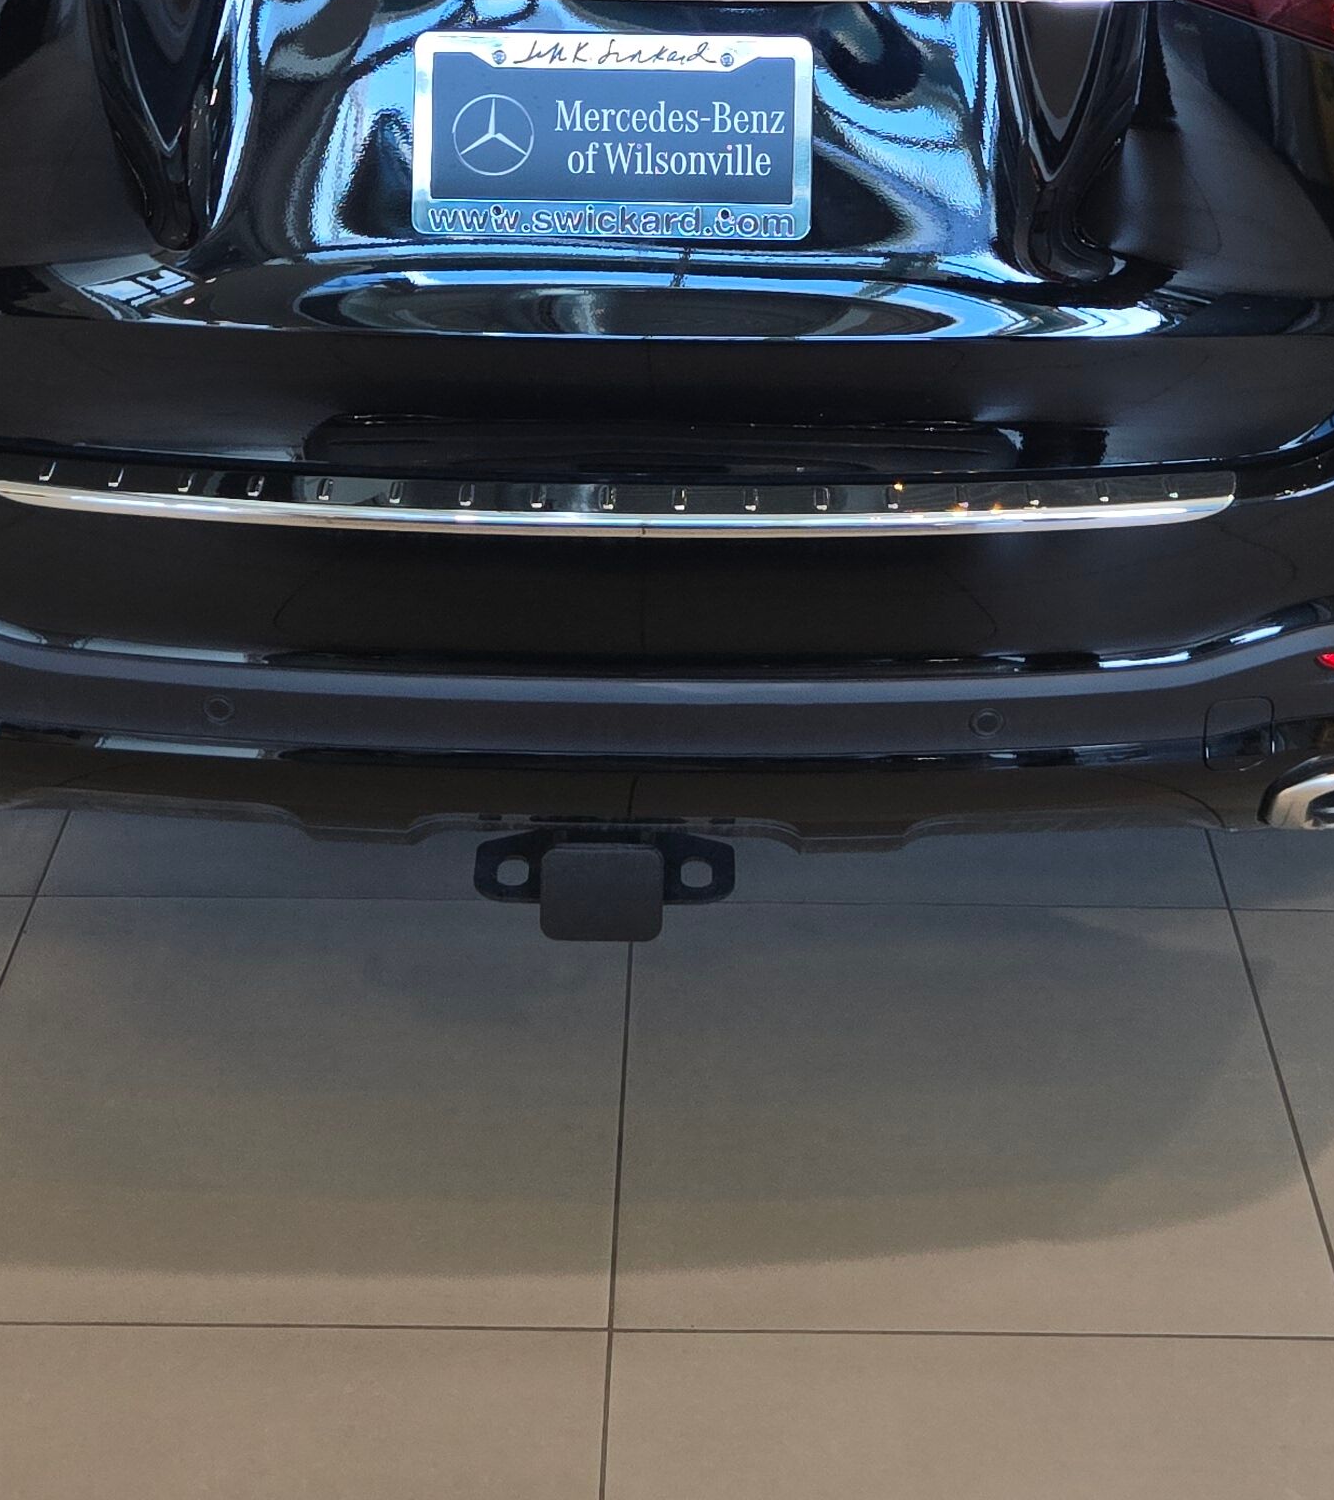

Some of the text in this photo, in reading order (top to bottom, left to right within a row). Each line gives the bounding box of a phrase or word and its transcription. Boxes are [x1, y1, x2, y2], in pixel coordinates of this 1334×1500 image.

[554, 99, 786, 134] Mercedes-Benz
[567, 141, 772, 177] of Wilsonville
[428, 203, 796, 237] www.swickard.com
